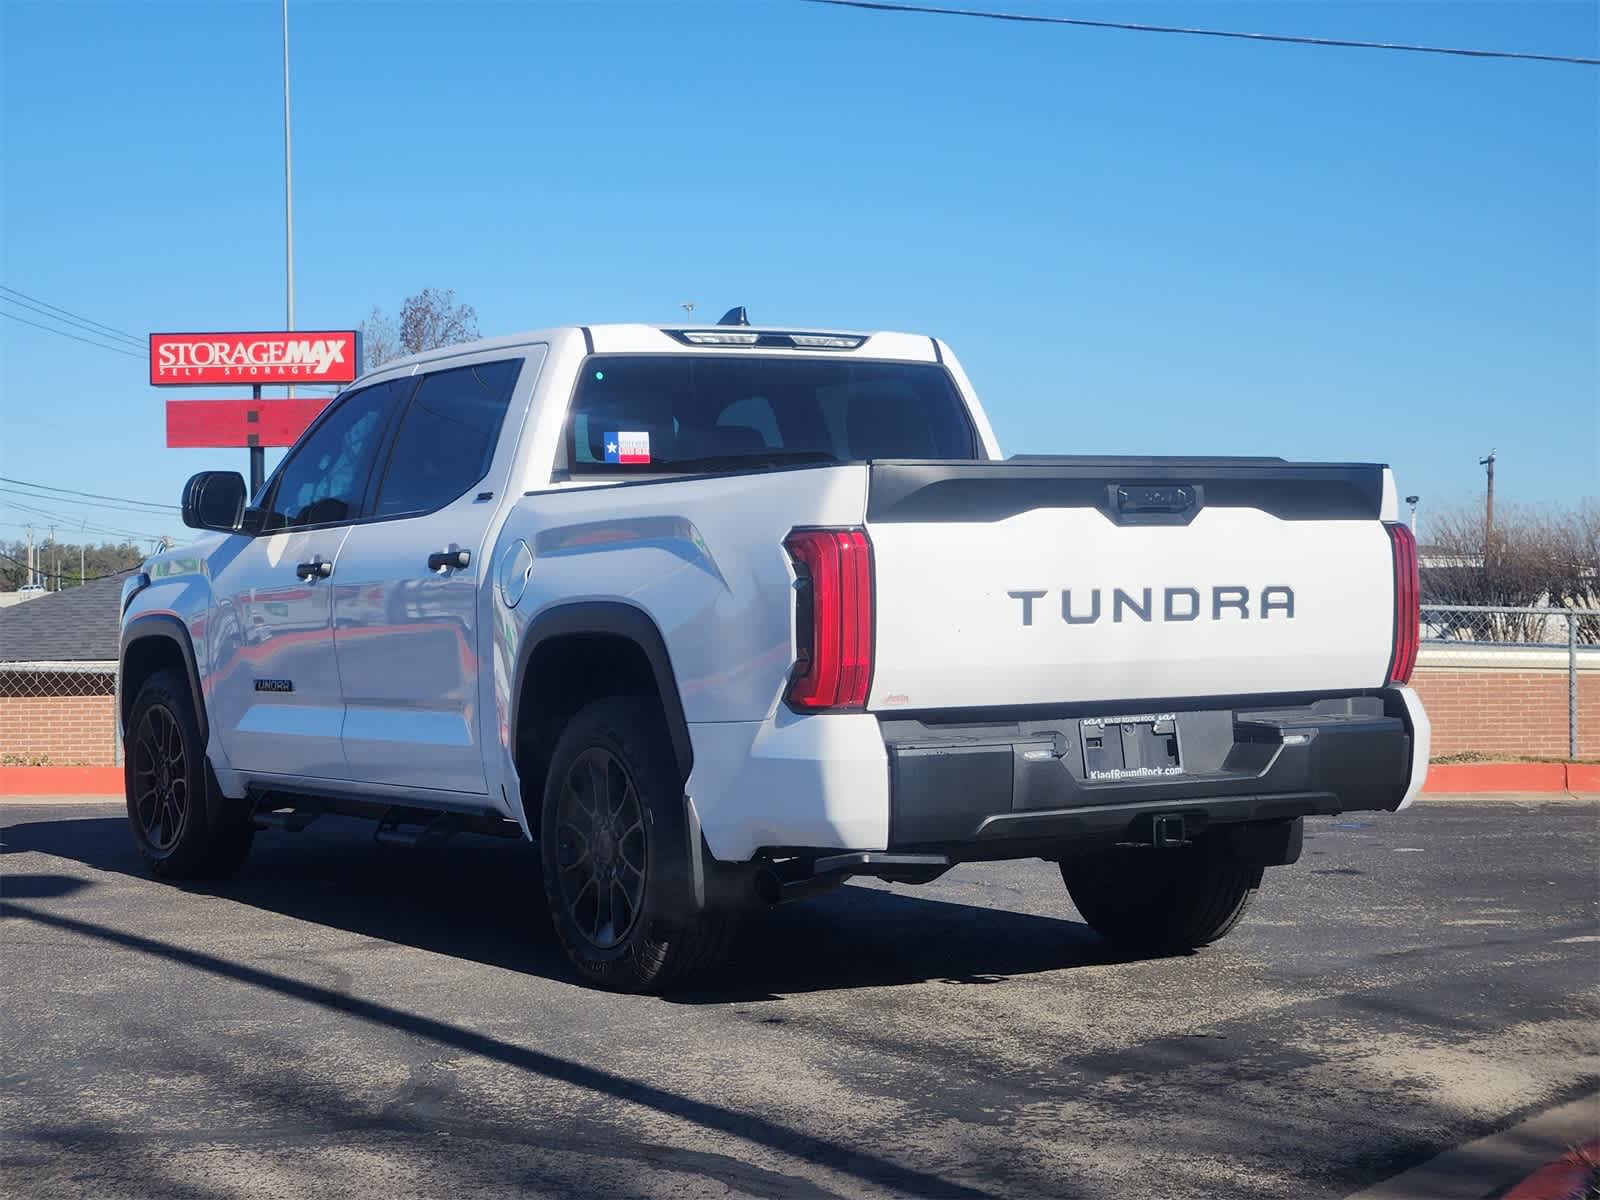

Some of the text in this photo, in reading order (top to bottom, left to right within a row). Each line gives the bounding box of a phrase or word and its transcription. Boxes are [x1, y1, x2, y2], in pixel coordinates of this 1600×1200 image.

[159, 366, 311, 376] SELF STORAGE
[1007, 586, 1295, 626] TUNDRA
[1090, 766, 1182, 779] KiaofRoundRock.com
